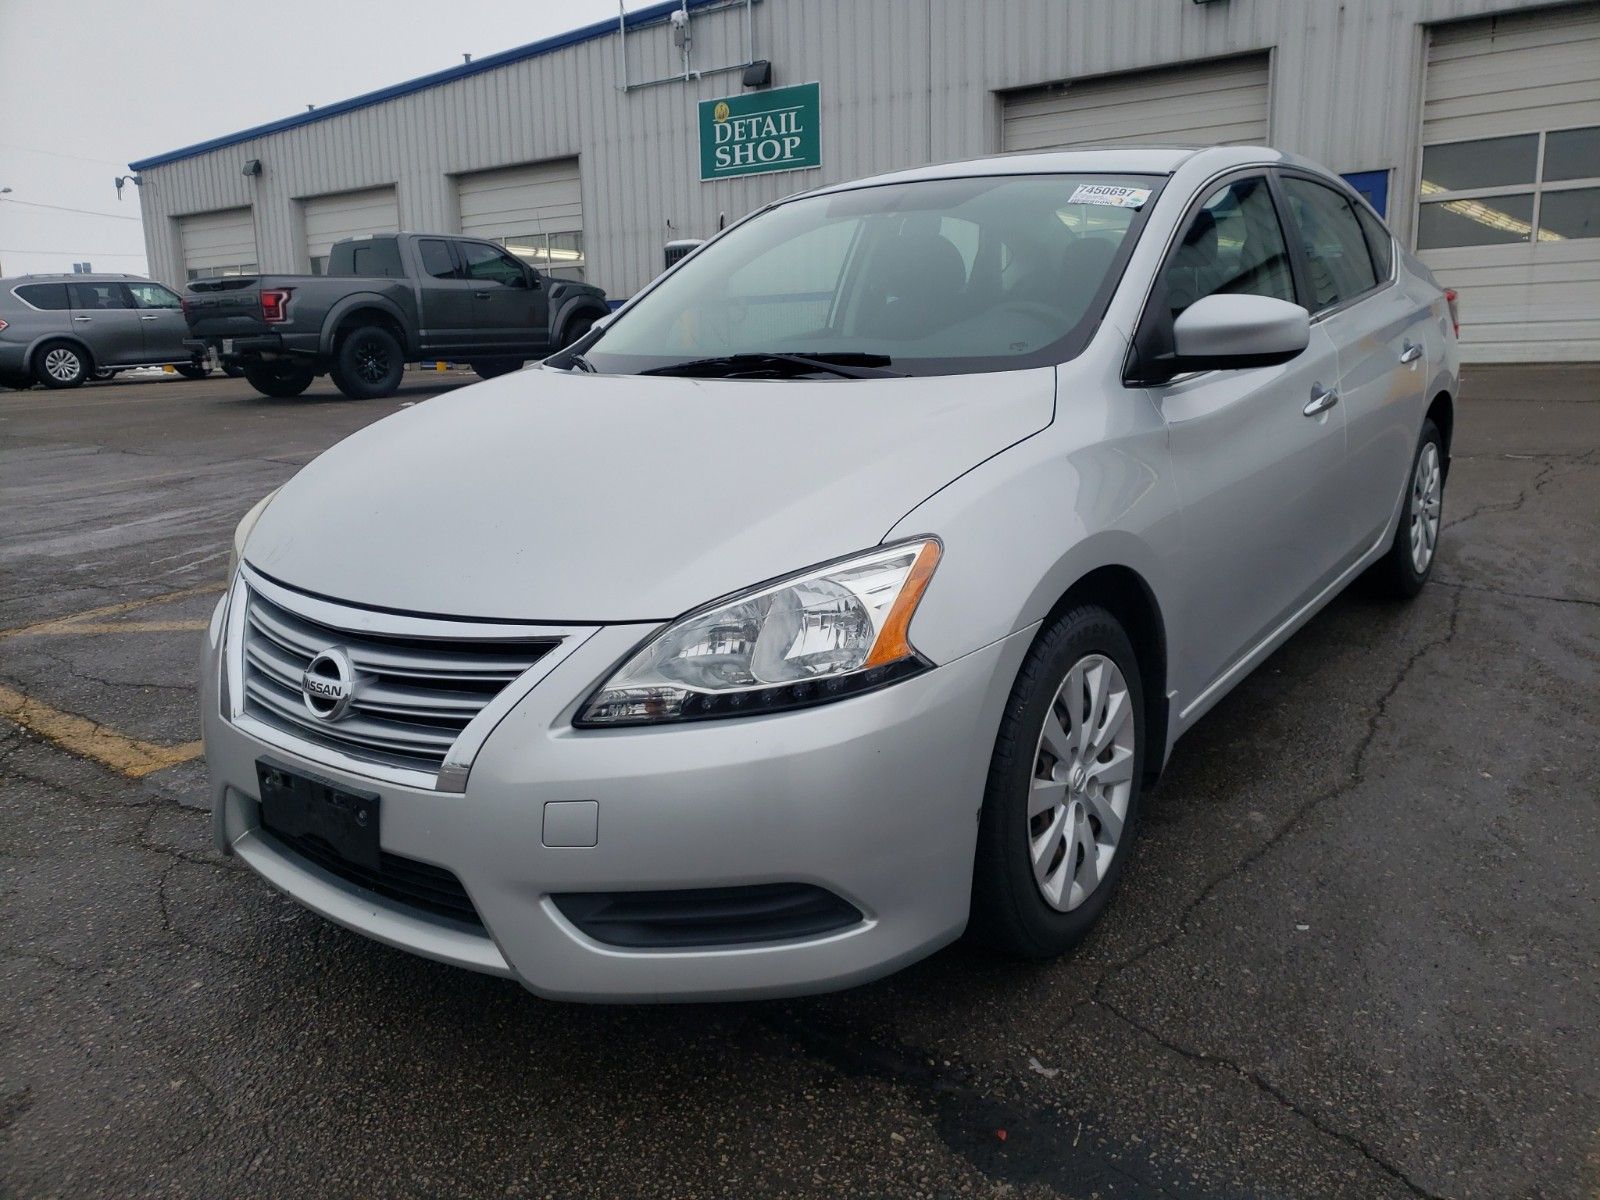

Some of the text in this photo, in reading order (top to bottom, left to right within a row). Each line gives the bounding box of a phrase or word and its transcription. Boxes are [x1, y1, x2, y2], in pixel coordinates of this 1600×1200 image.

[713, 111, 803, 144] DETAIL
[715, 136, 801, 168] SHOP
[1078, 185, 1137, 197] 7450697
[304, 679, 342, 697] NISSAN
